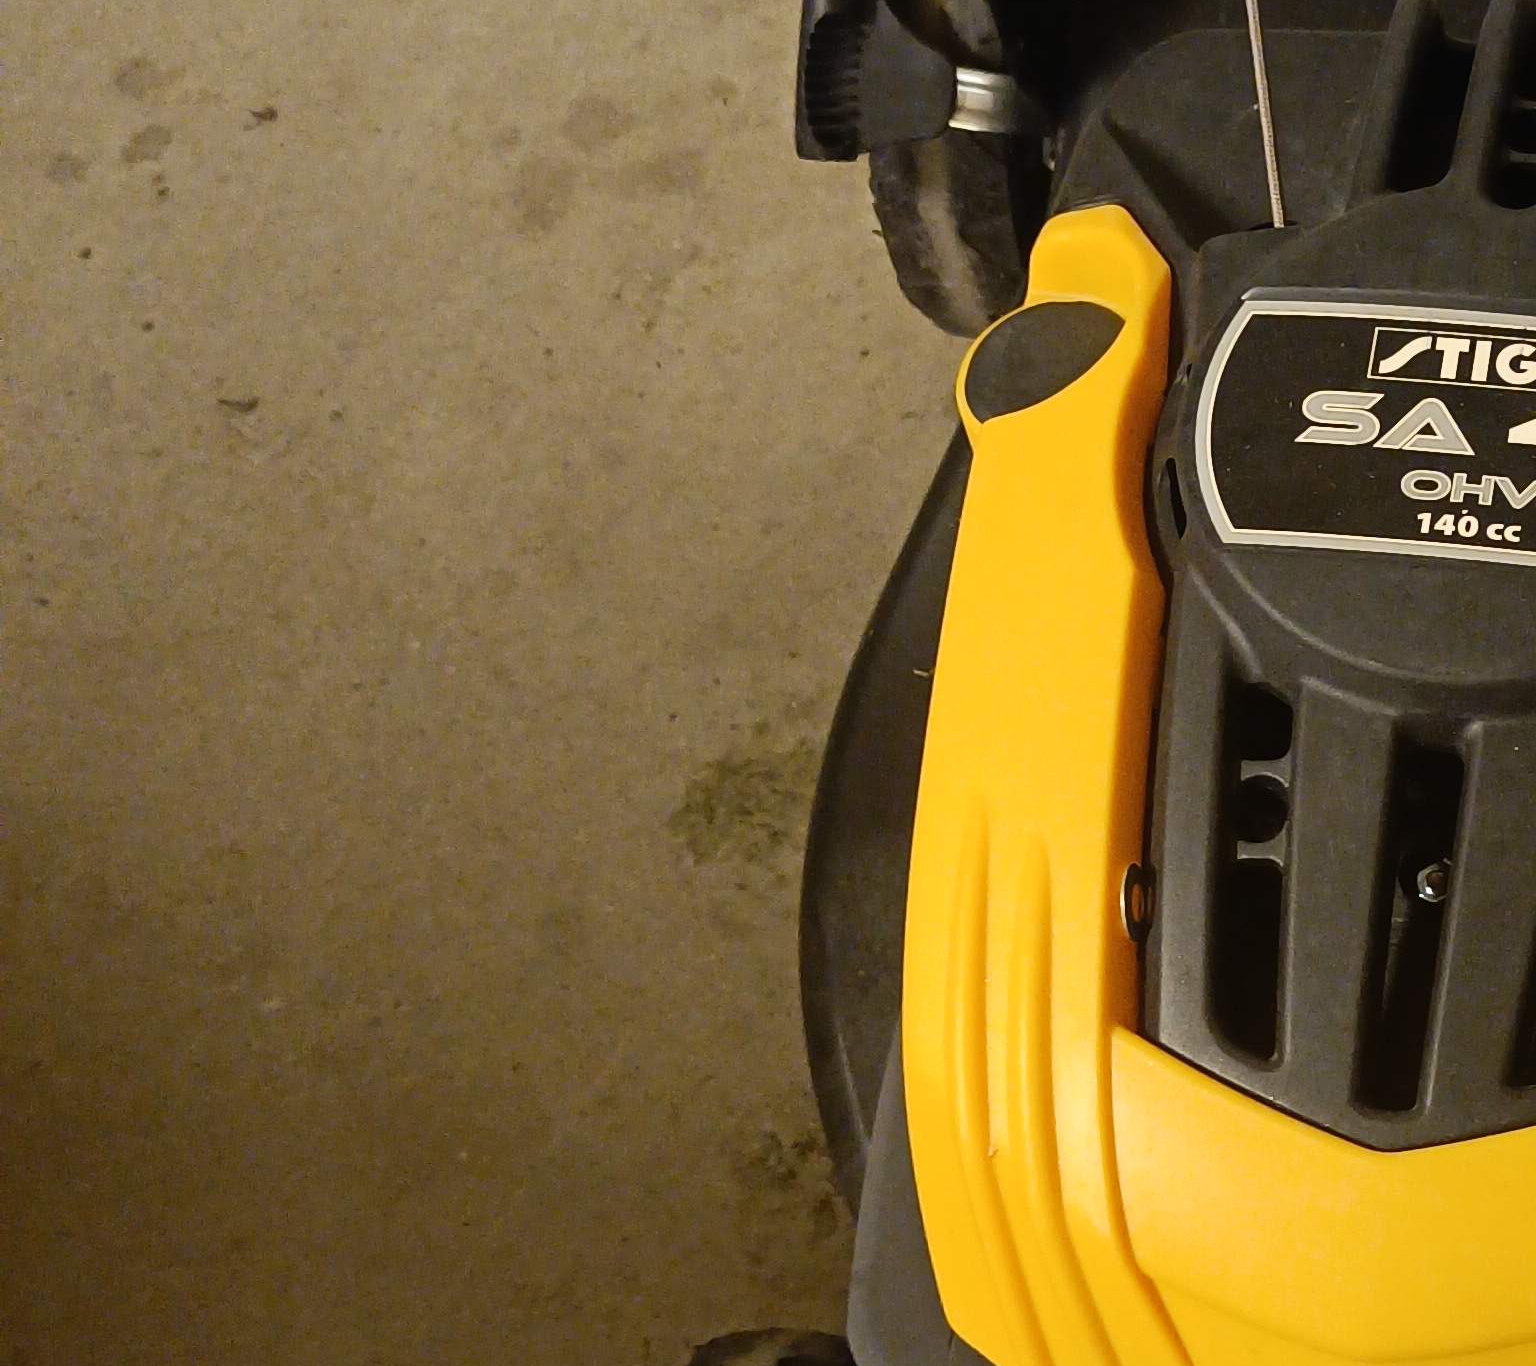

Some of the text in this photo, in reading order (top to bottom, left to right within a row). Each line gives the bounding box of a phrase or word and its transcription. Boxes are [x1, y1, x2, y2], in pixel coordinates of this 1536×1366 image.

[1294, 390, 1475, 456] SA
[1416, 511, 1522, 543] 140 cc
